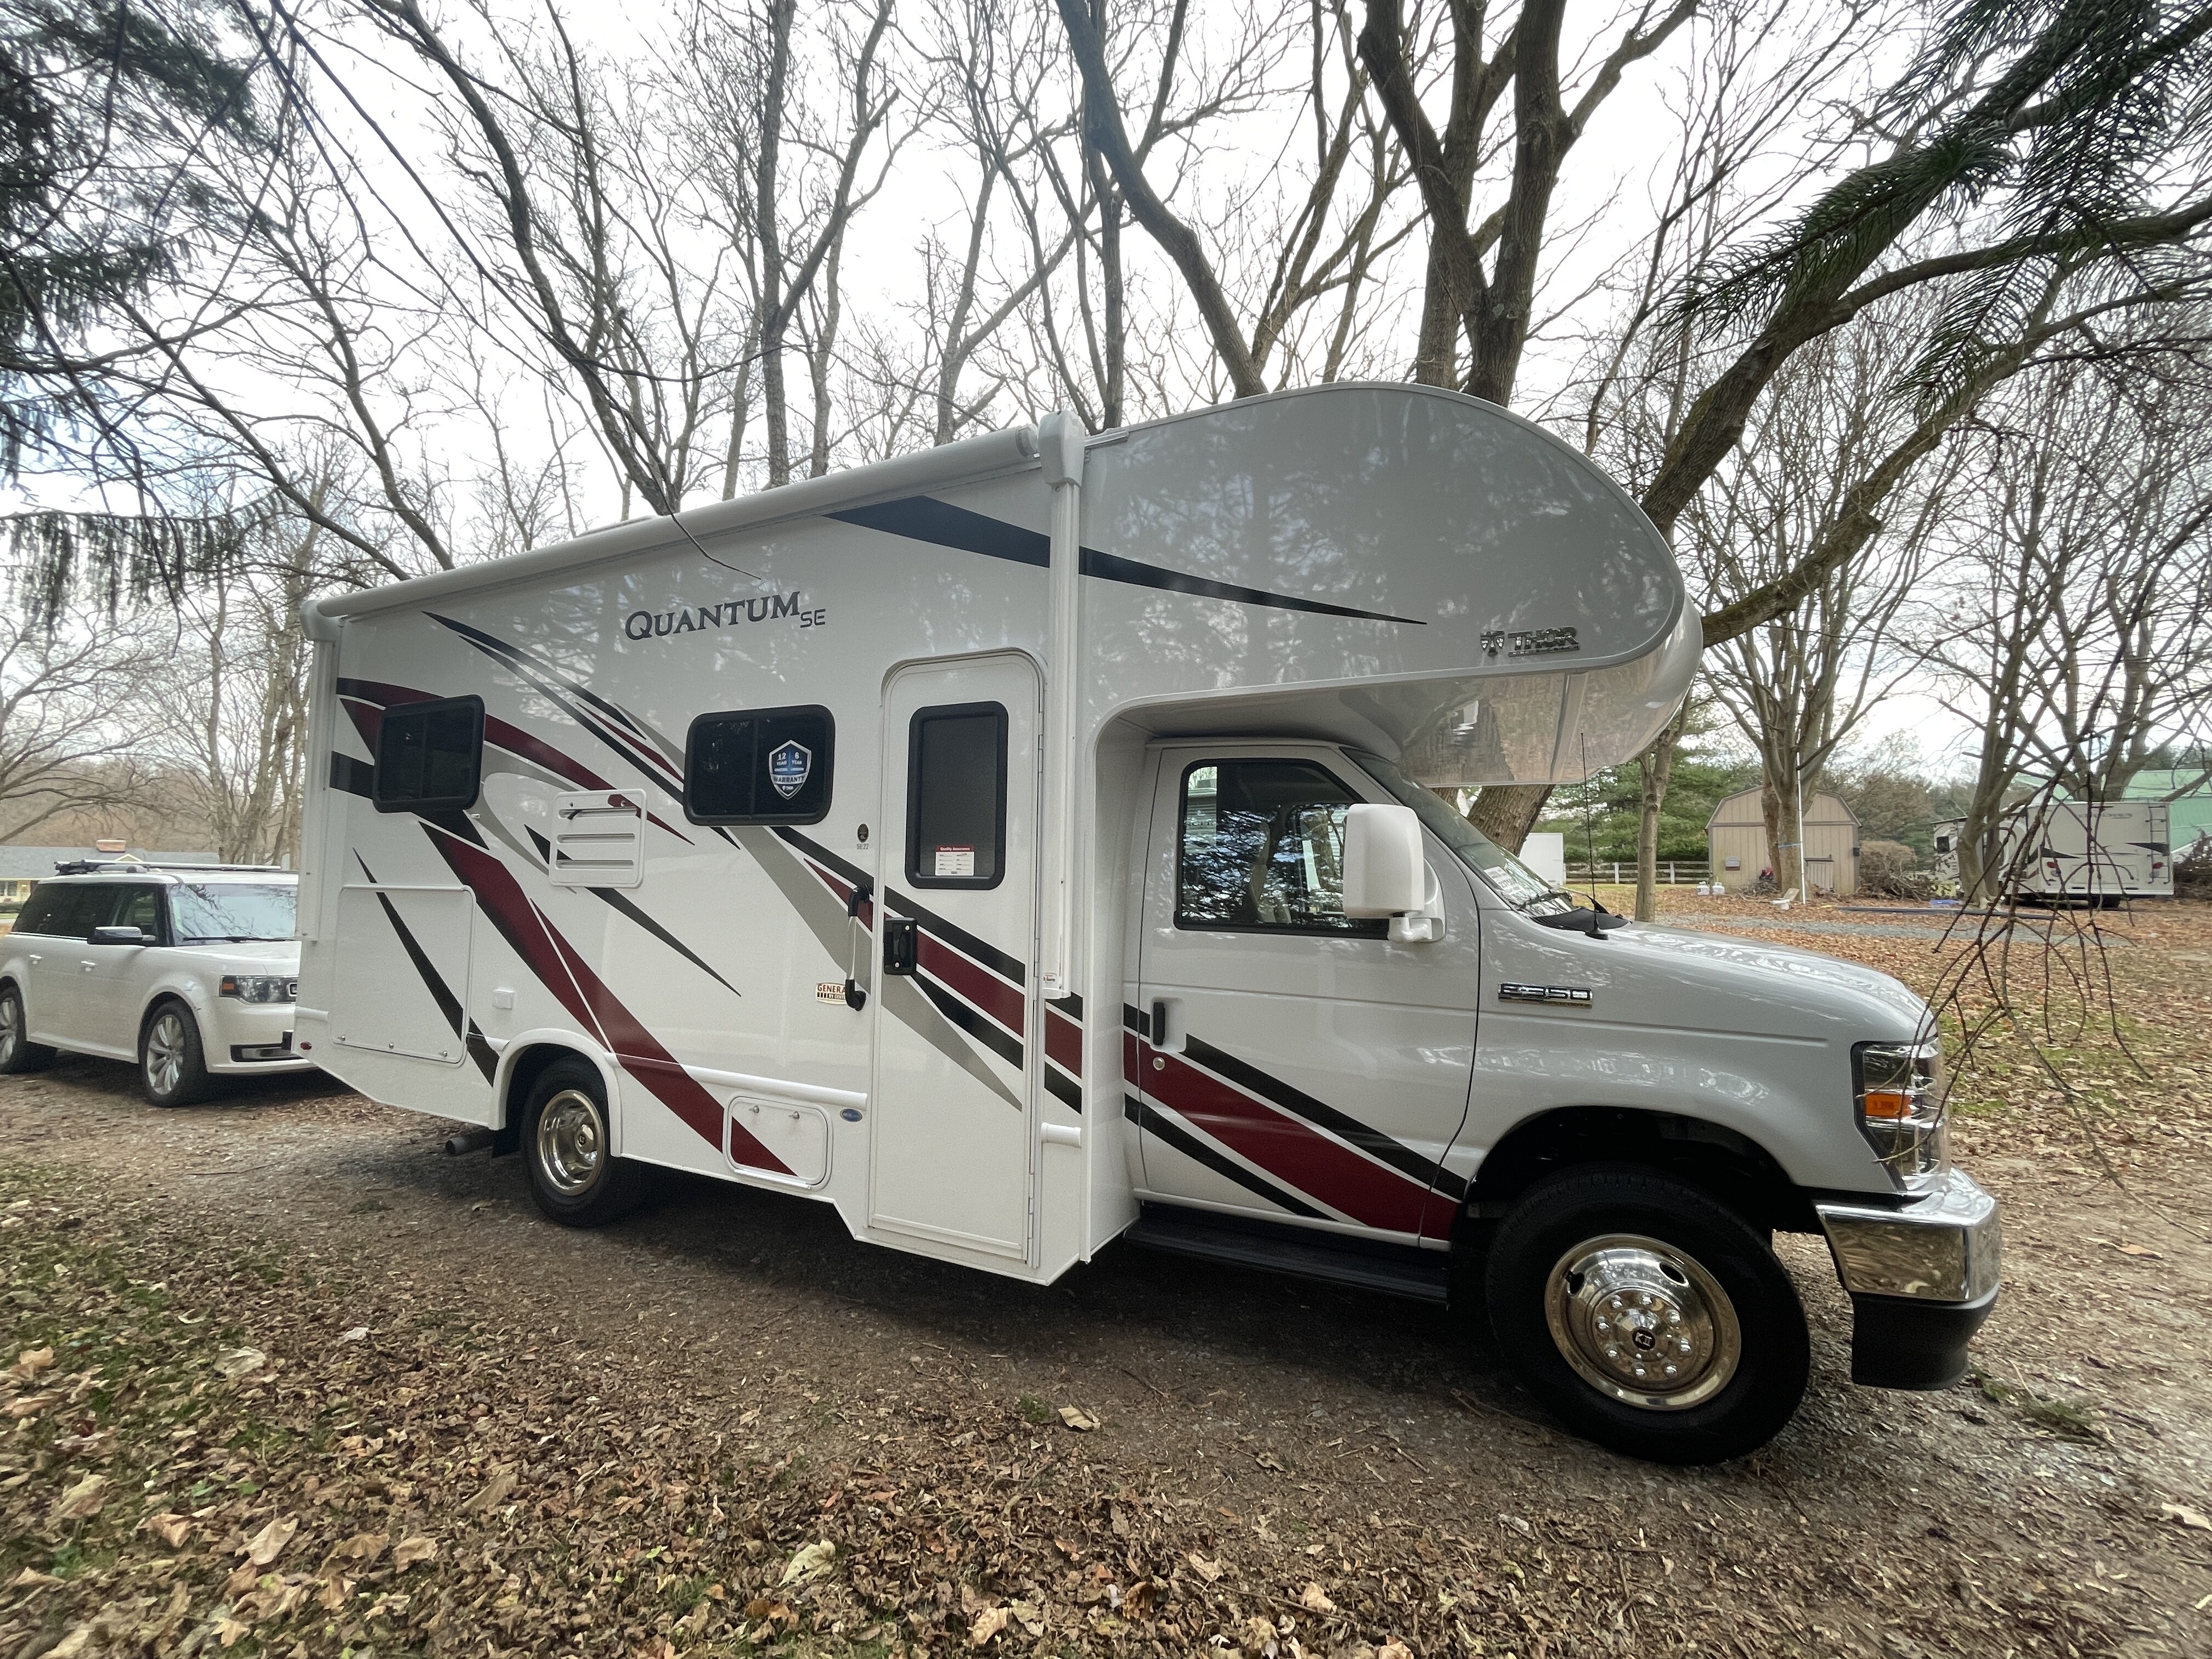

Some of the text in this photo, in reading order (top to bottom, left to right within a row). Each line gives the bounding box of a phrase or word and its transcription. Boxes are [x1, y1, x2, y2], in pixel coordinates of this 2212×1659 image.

[625, 591, 826, 641] QUANTUM SE
[1508, 627, 1579, 651] THOR
[777, 752, 787, 760] 12
[817, 984, 845, 994] GENERA
